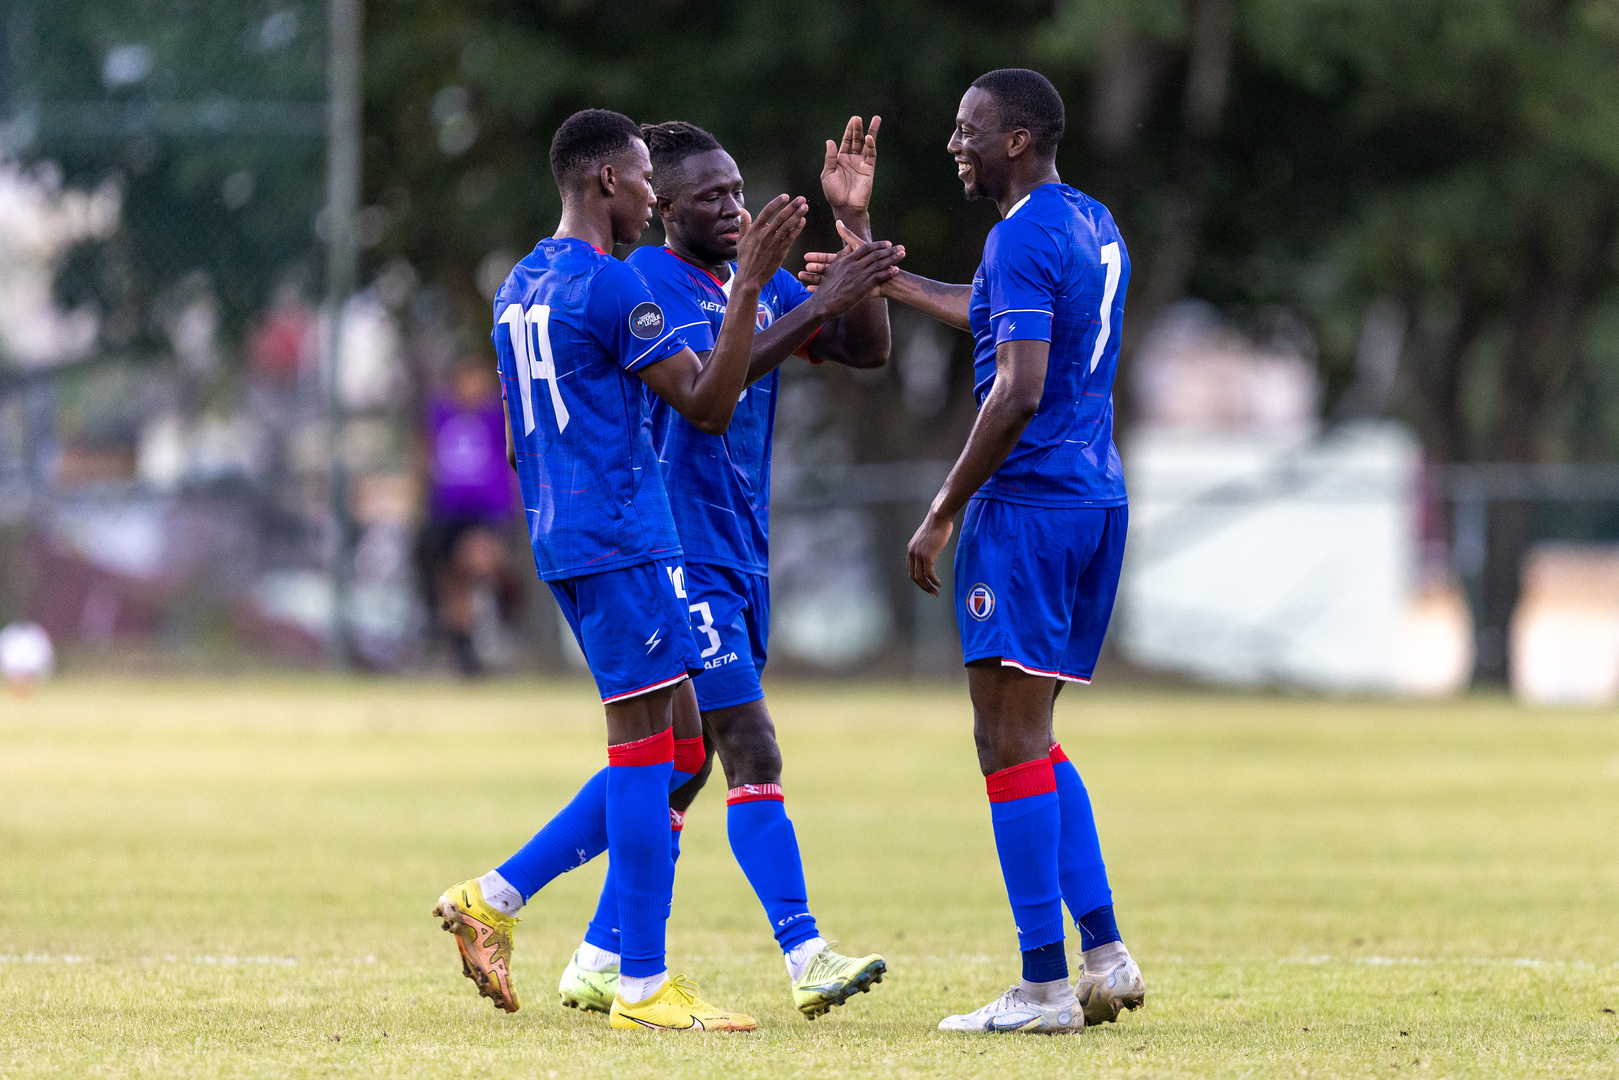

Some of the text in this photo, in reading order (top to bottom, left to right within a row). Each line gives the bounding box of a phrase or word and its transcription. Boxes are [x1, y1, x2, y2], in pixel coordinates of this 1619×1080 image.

[698, 299, 726, 314] AETA
[498, 303, 570, 437] 19
[689, 601, 722, 658] 3
[704, 651, 738, 670] AETA
